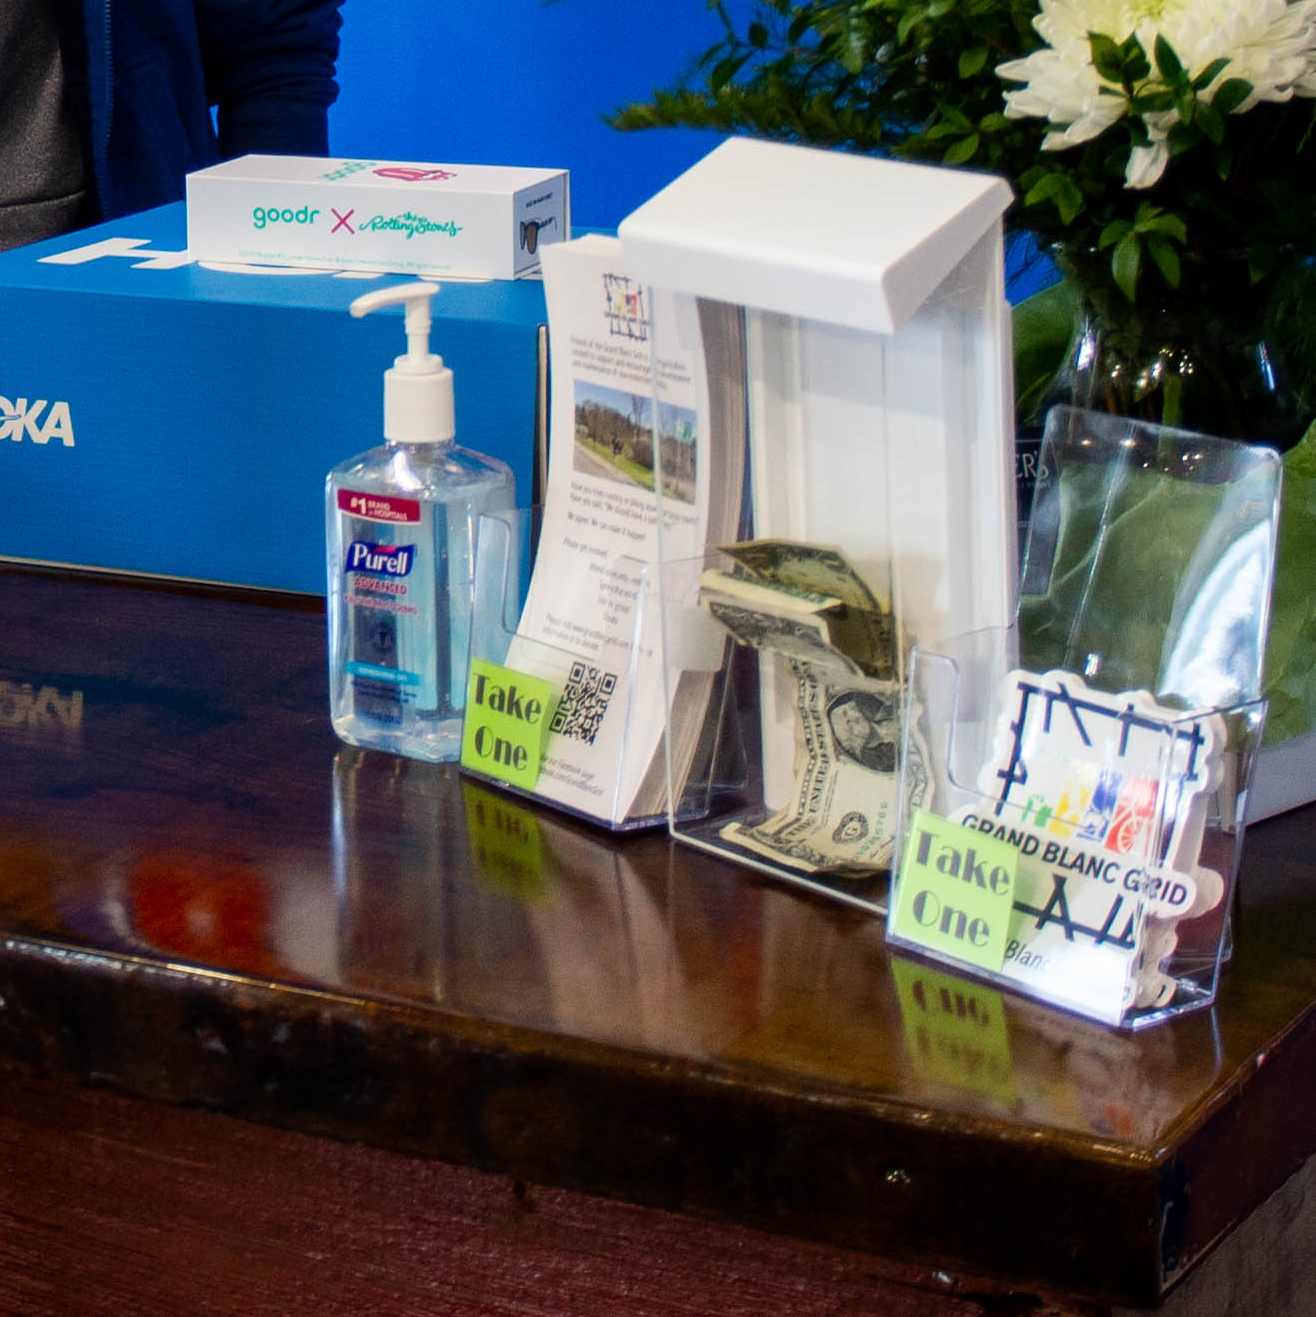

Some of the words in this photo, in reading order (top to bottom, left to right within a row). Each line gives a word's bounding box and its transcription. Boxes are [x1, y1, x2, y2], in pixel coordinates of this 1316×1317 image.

[253, 205, 320, 229] goodr
[350, 497, 366, 515] #1
[472, 672, 542, 725] Take
[475, 725, 528, 771] One
[916, 827, 1010, 896] Take
[1042, 842, 1120, 884] BLANC
[912, 890, 990, 947] One
